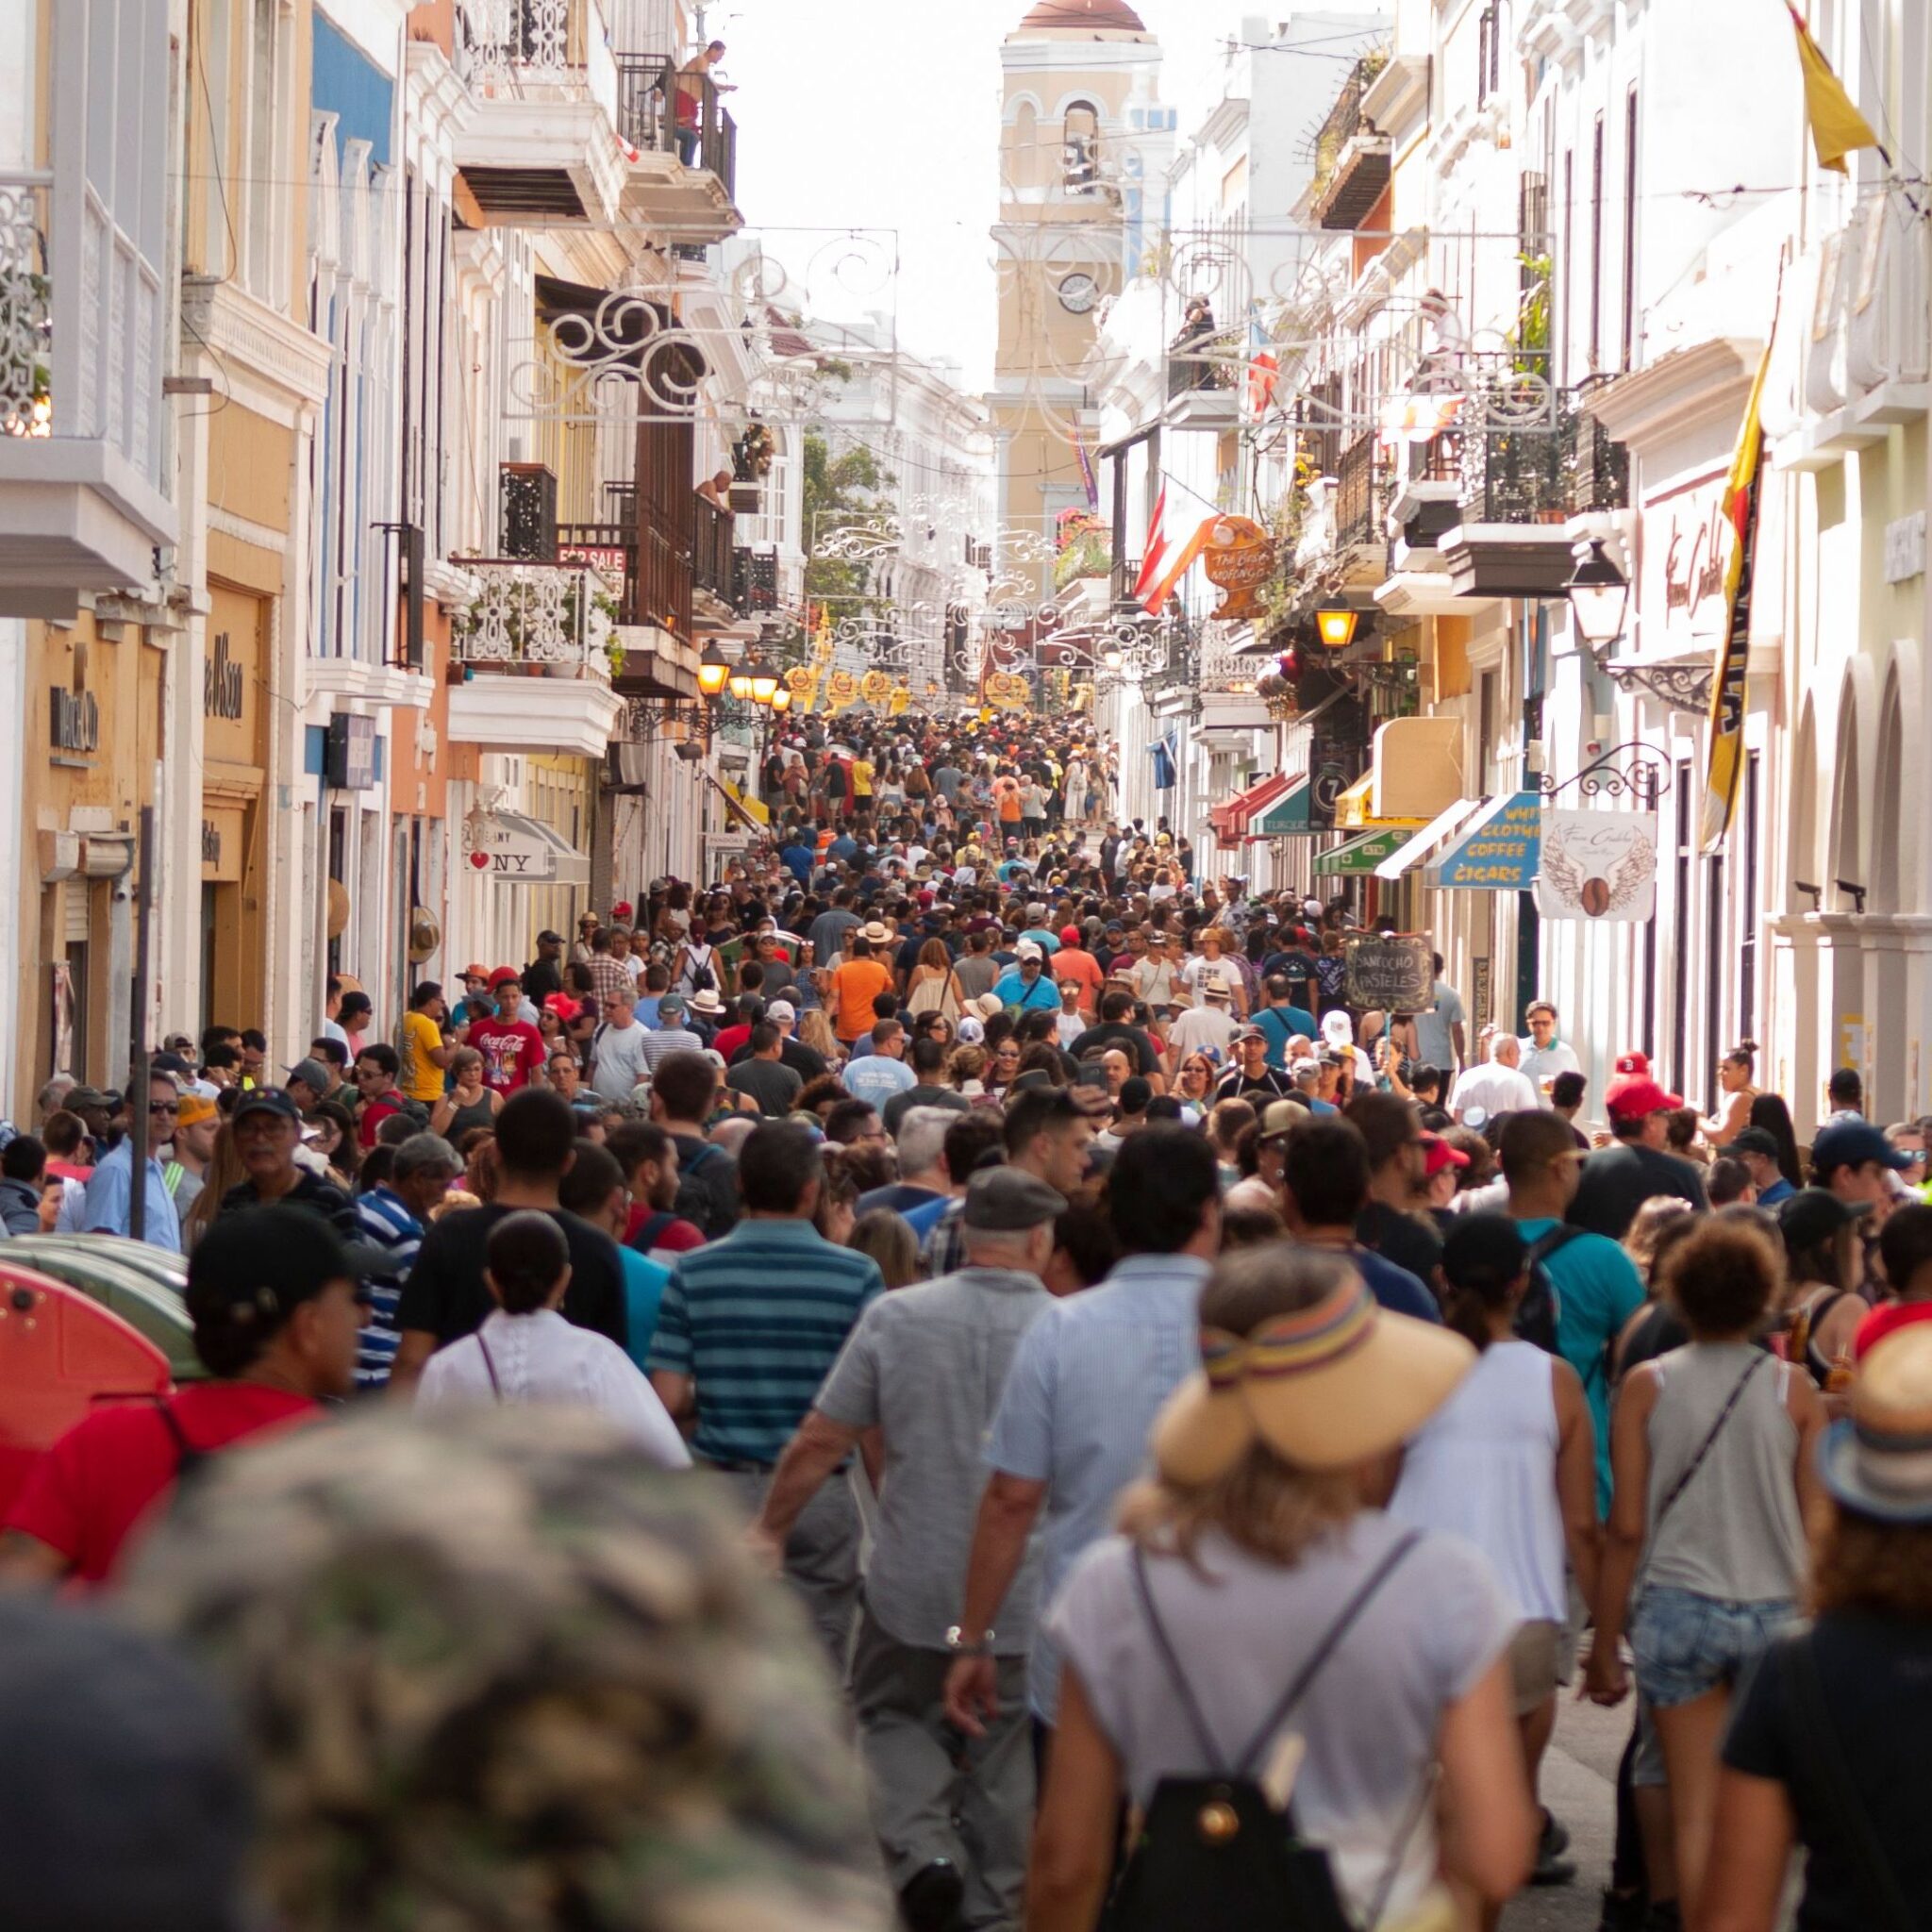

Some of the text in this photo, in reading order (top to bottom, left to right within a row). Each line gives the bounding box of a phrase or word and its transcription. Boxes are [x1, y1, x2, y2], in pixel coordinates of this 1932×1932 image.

[590, 551, 623, 570] SALE
[1327, 780, 1340, 802] 7
[1467, 842, 1525, 858] COFFEE
[491, 854, 530, 872] NY
[1454, 865, 1522, 882] CIGARS
[1359, 974, 1420, 989] PASTELES
